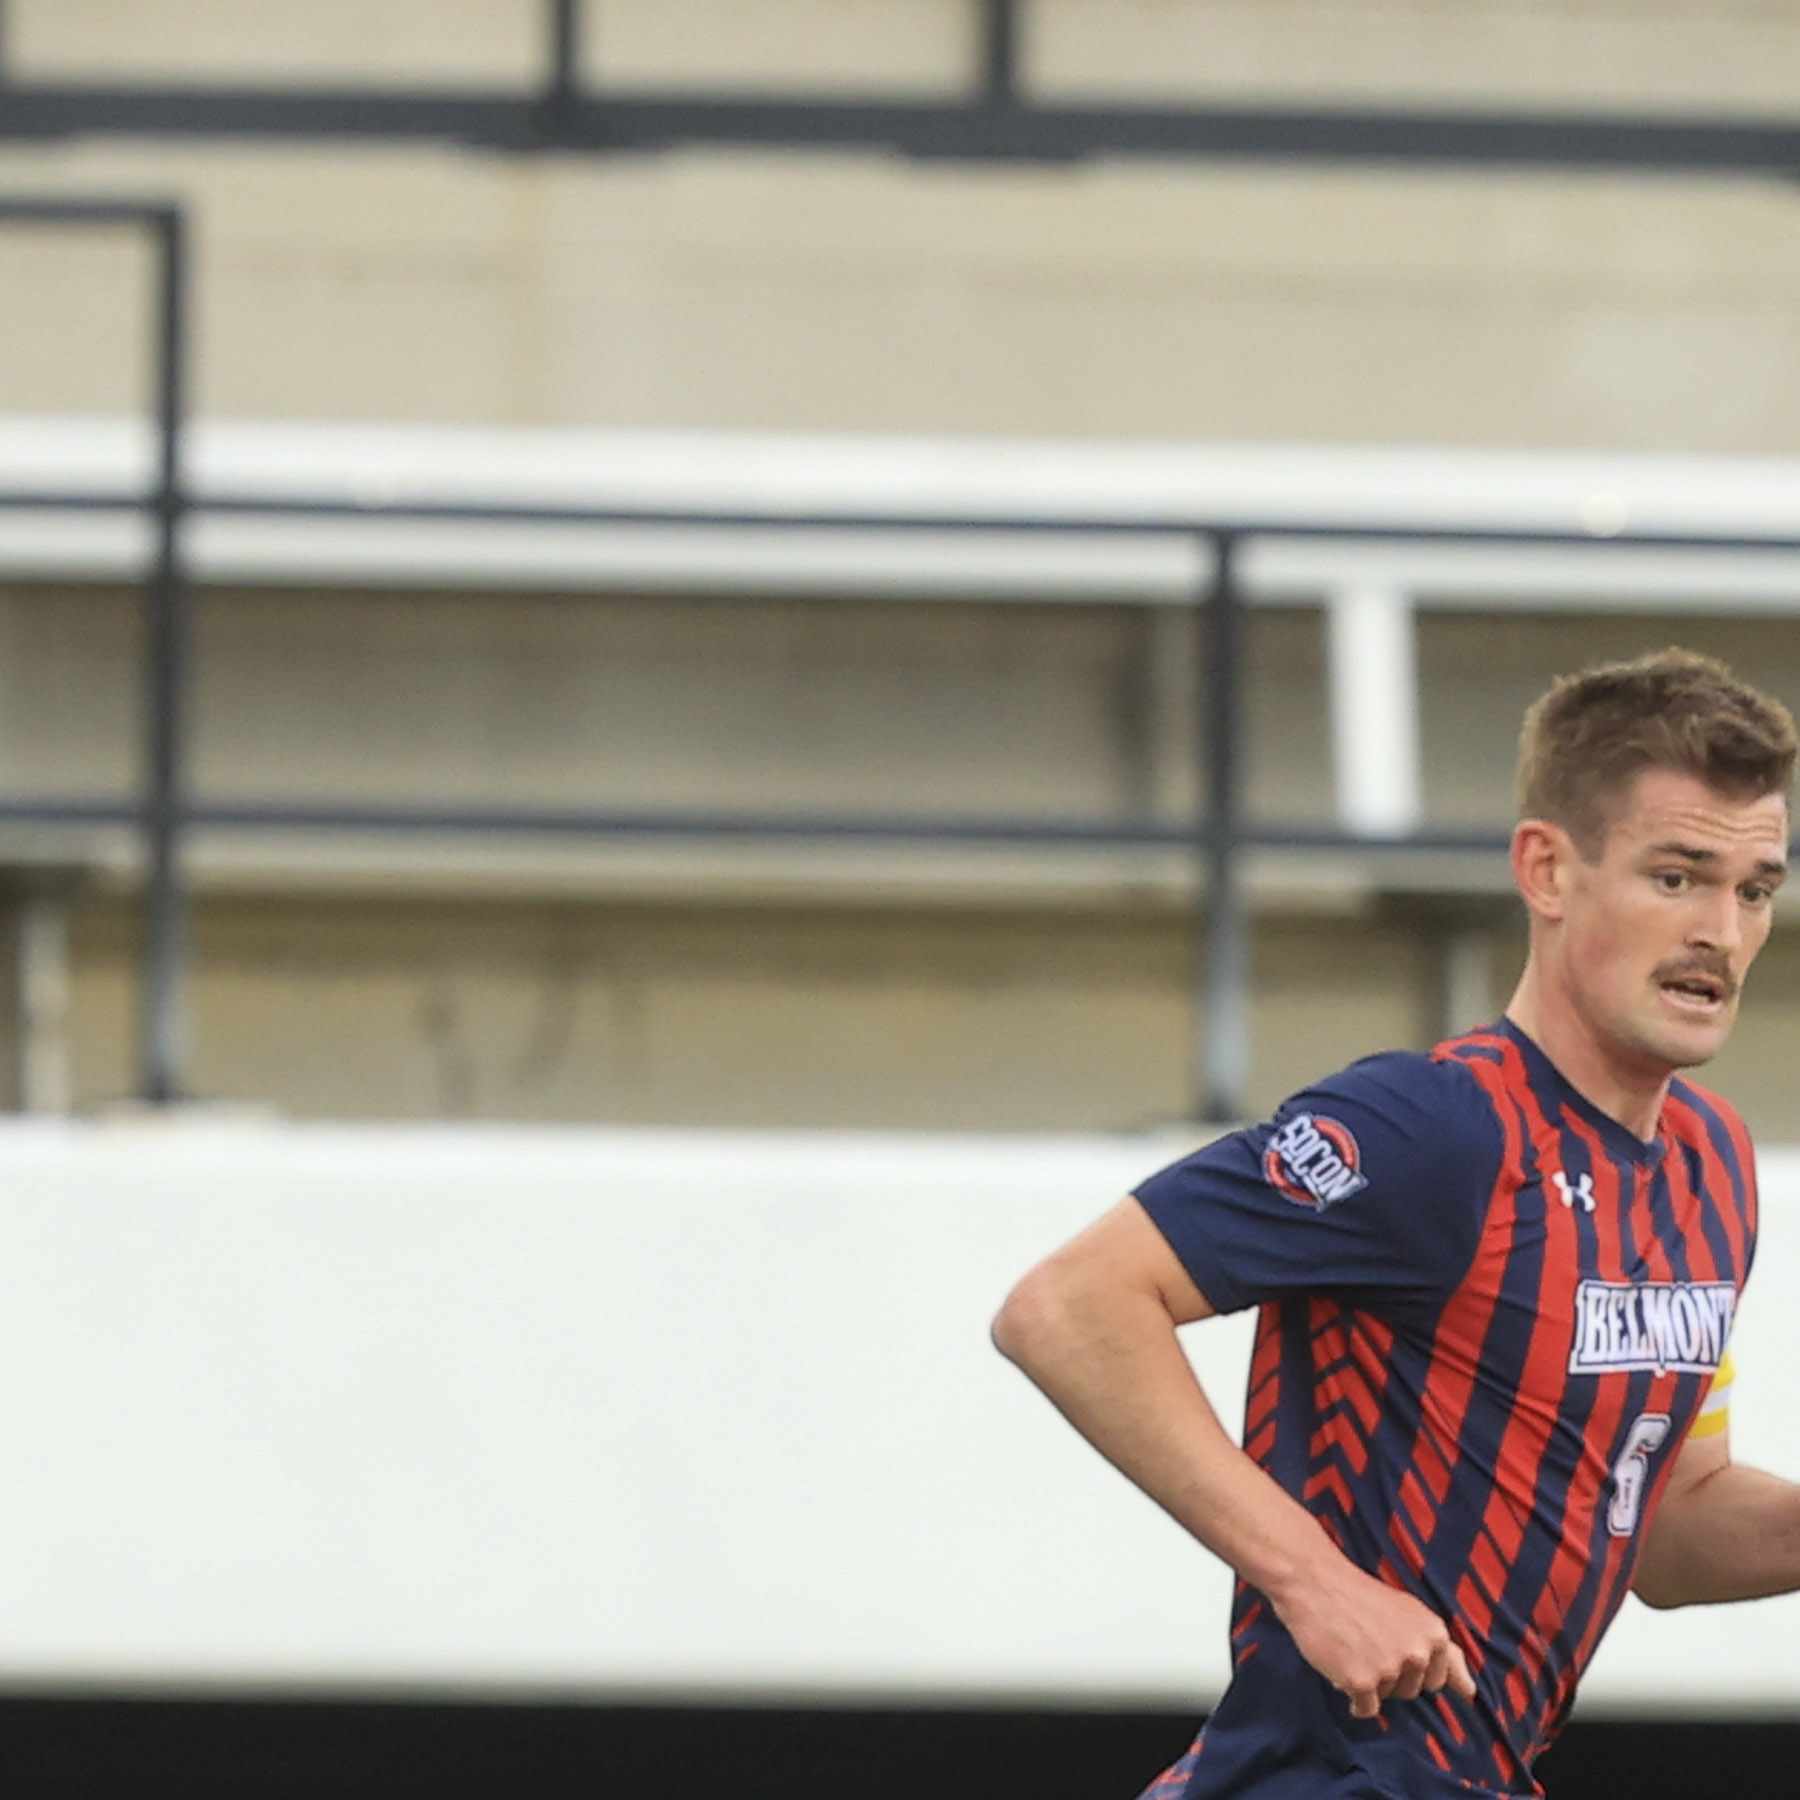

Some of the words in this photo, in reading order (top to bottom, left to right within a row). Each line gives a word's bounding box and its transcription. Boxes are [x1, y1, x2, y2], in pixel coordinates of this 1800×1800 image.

[1270, 1111, 1365, 1205] SOCON
[1574, 1282, 1737, 1370] BELMONT
[1608, 1413, 1671, 1537] 6
